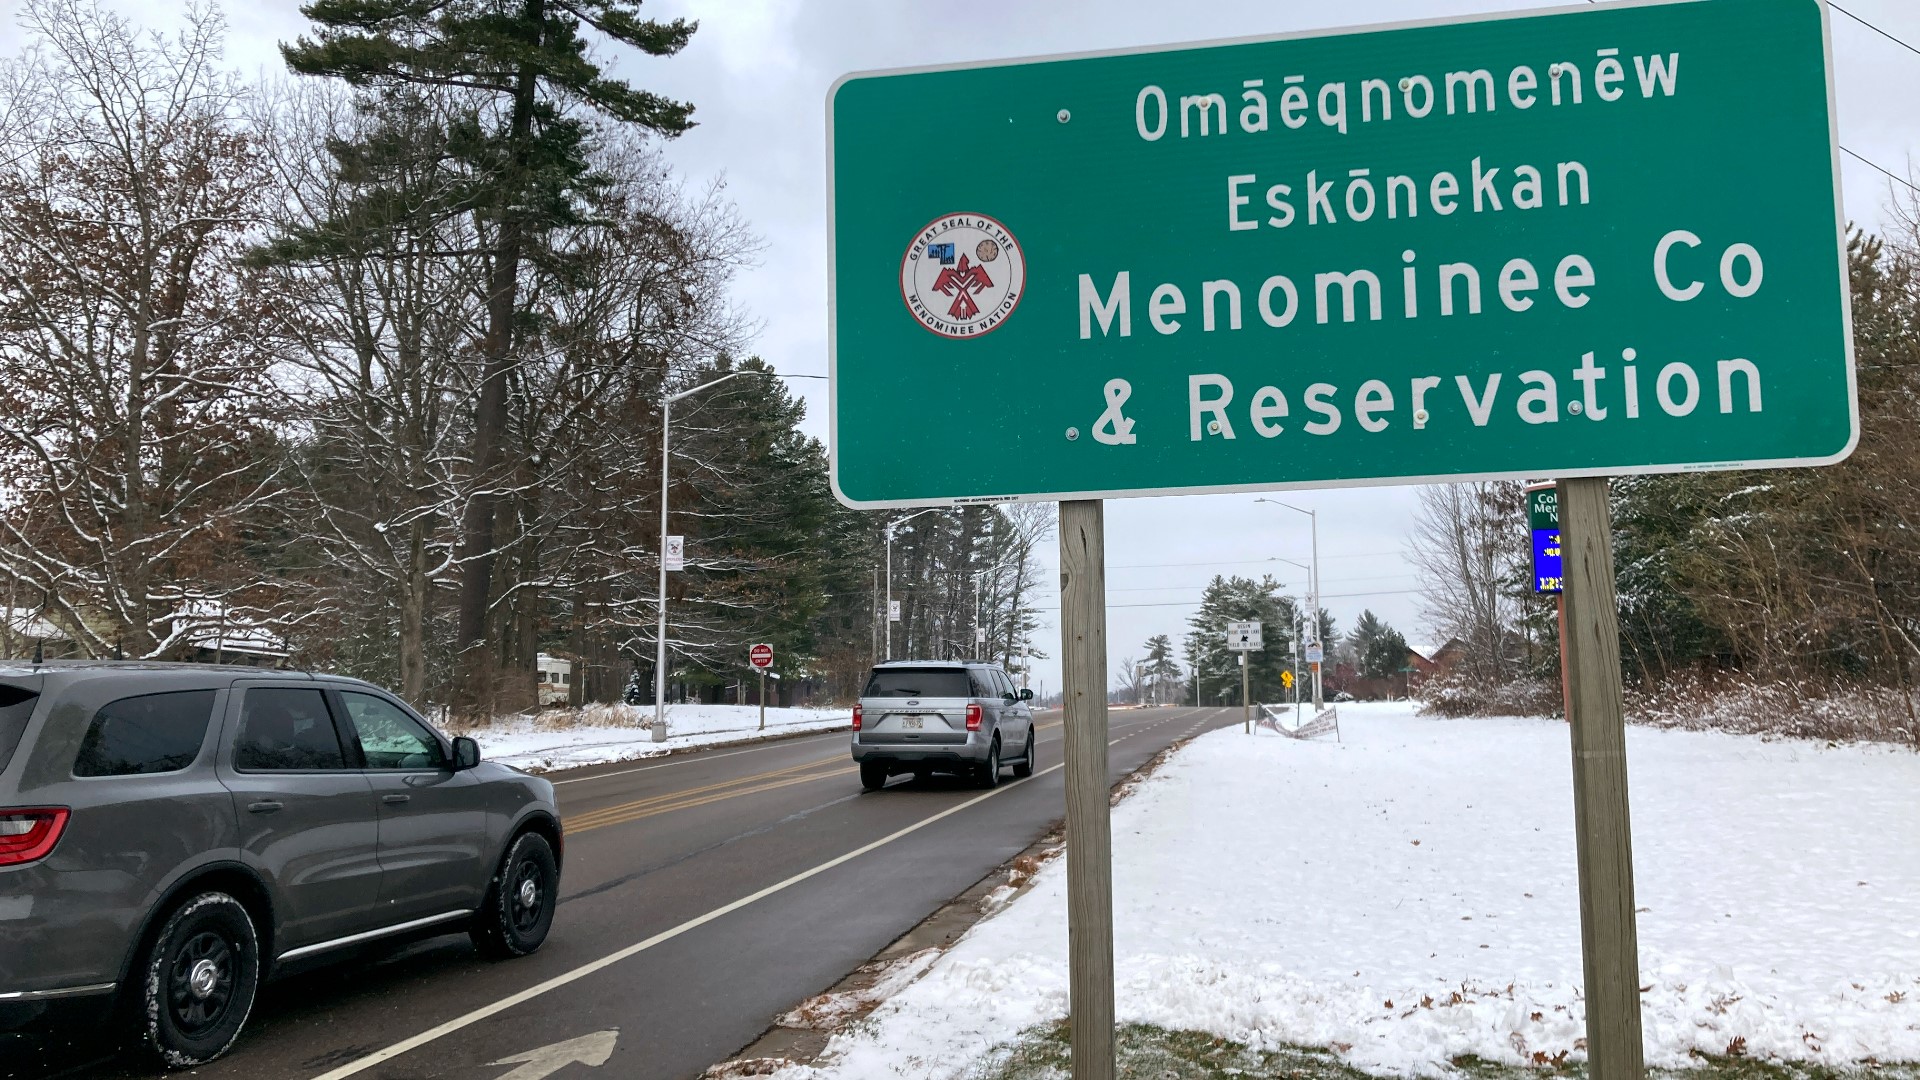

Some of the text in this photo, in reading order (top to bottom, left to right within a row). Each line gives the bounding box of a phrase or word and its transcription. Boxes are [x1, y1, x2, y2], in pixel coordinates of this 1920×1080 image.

[1135, 48, 1679, 141] Omāēqnomenēw
[1227, 156, 1590, 231] Eskōnekan
[910, 218, 1014, 261] GREAT SEAL OF THE
[909, 292, 1017, 335] MENOMINEE NATION
[1077, 230, 1763, 339] Menominee Co
[1091, 347, 1762, 445] & Reservation
